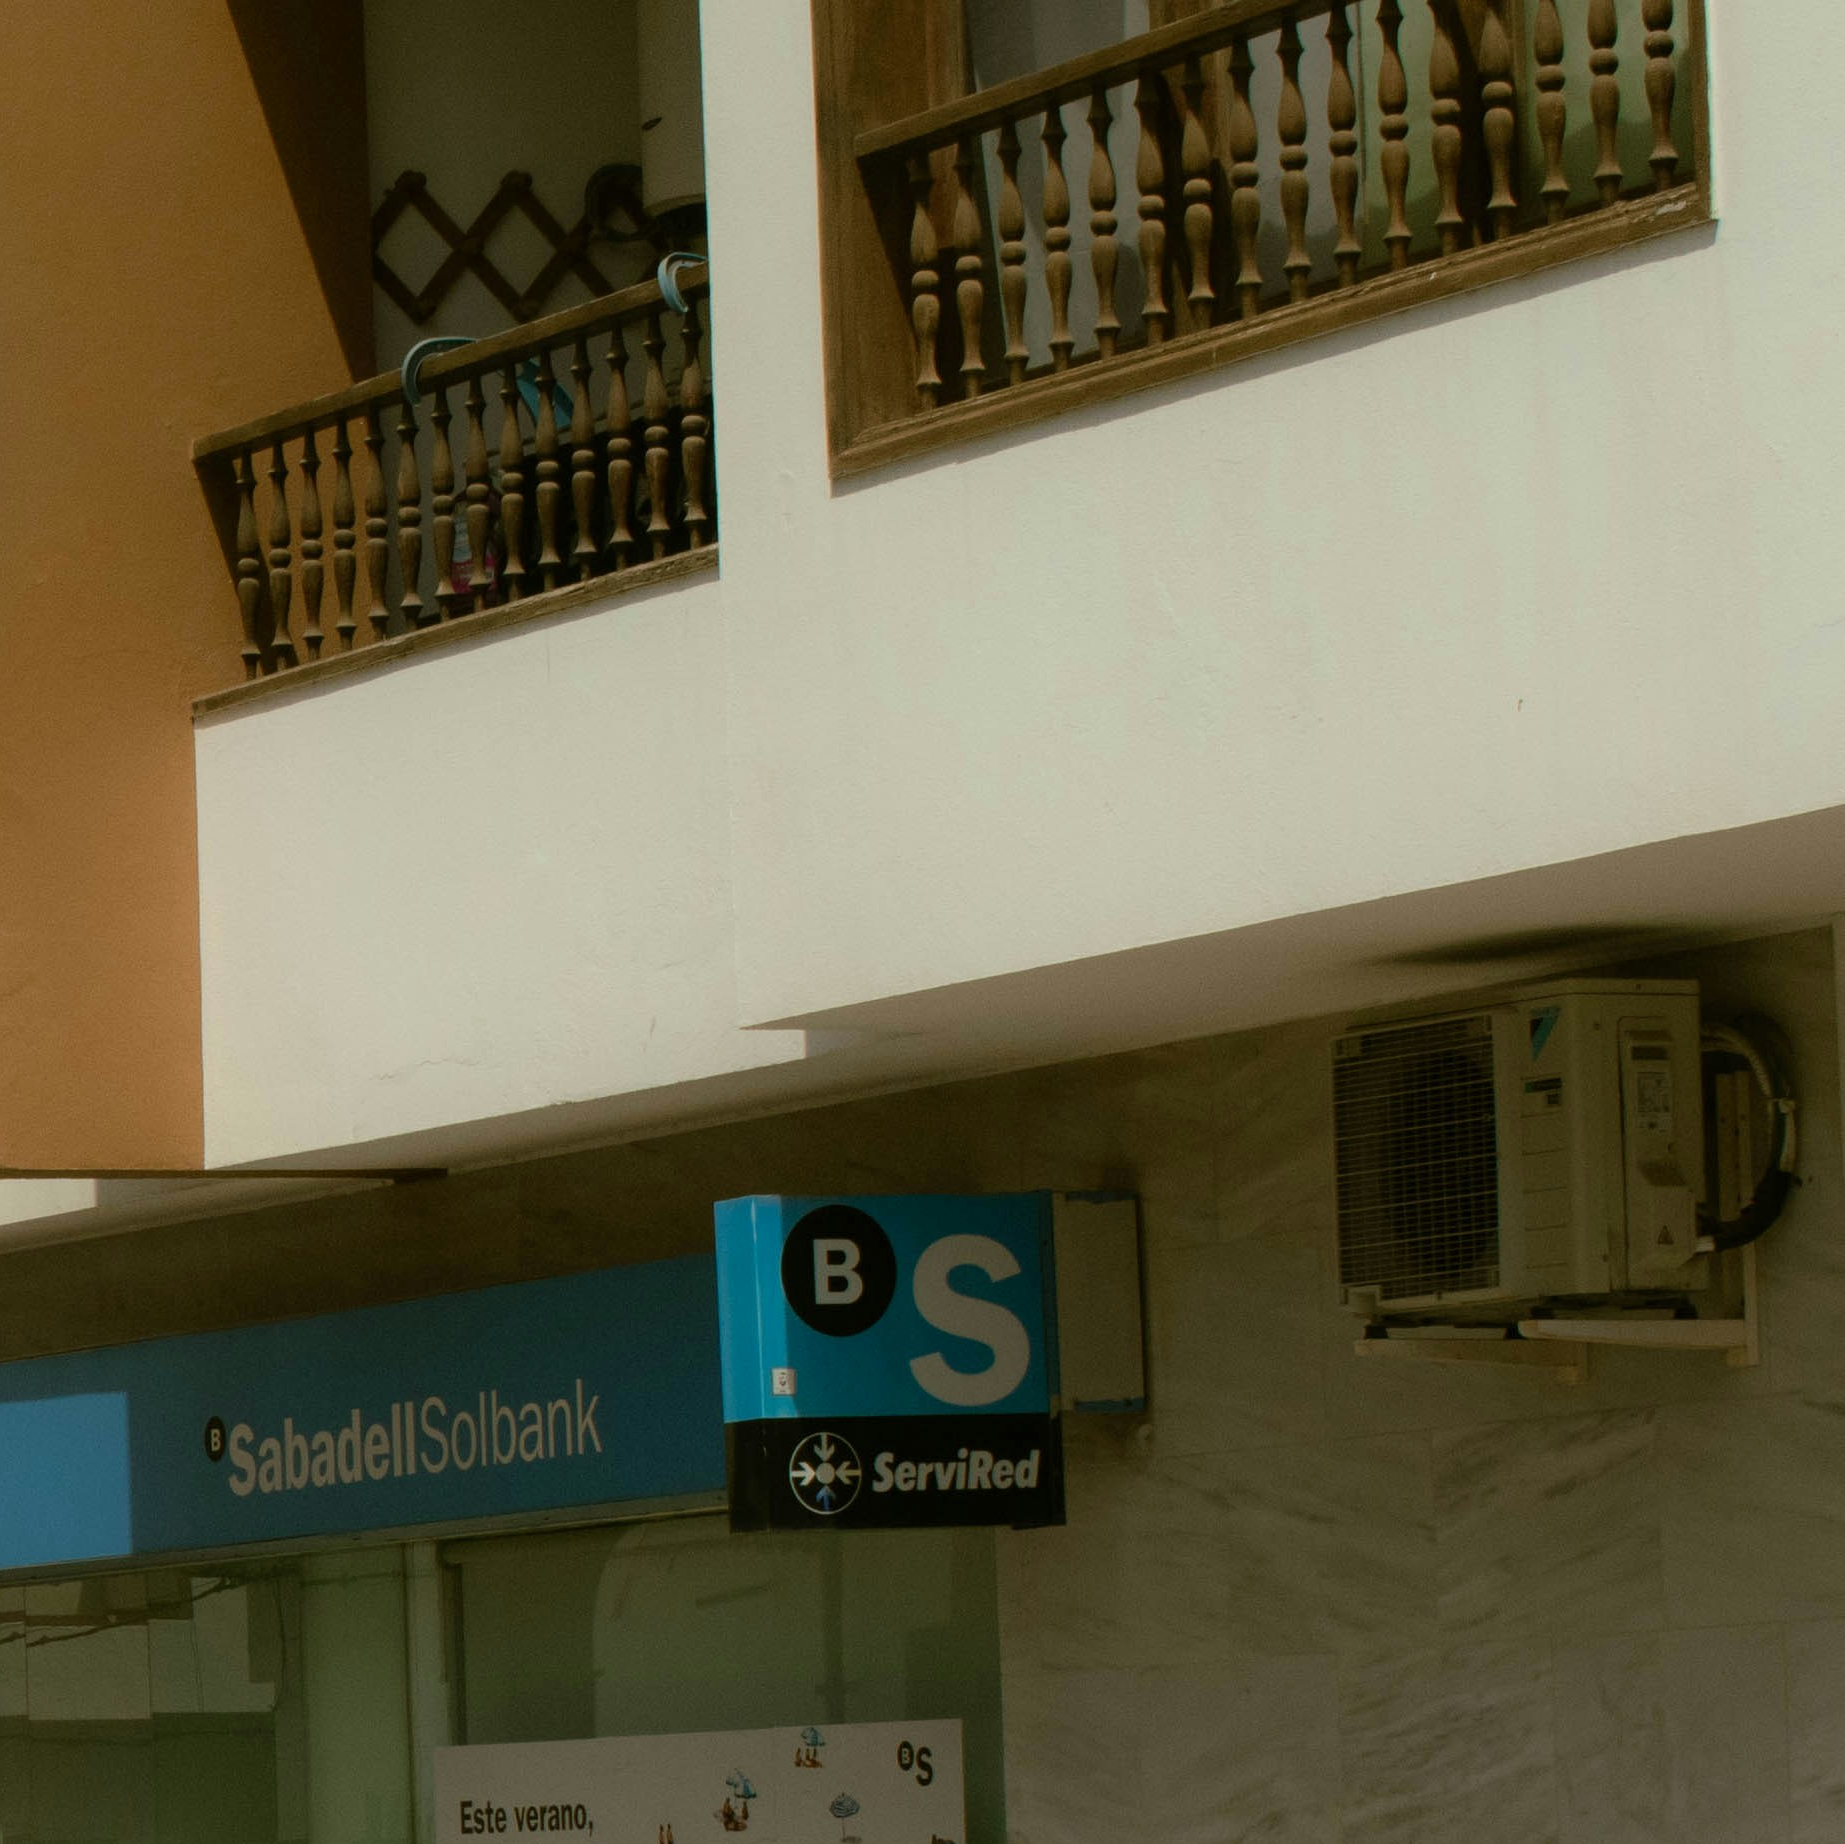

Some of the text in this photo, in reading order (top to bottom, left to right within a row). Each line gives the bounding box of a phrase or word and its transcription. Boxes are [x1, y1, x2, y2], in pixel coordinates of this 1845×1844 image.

[813, 1233, 1031, 1407] B S
[872, 1448, 1040, 1494] ServiRed
[460, 1801, 594, 1837] Este verano,
